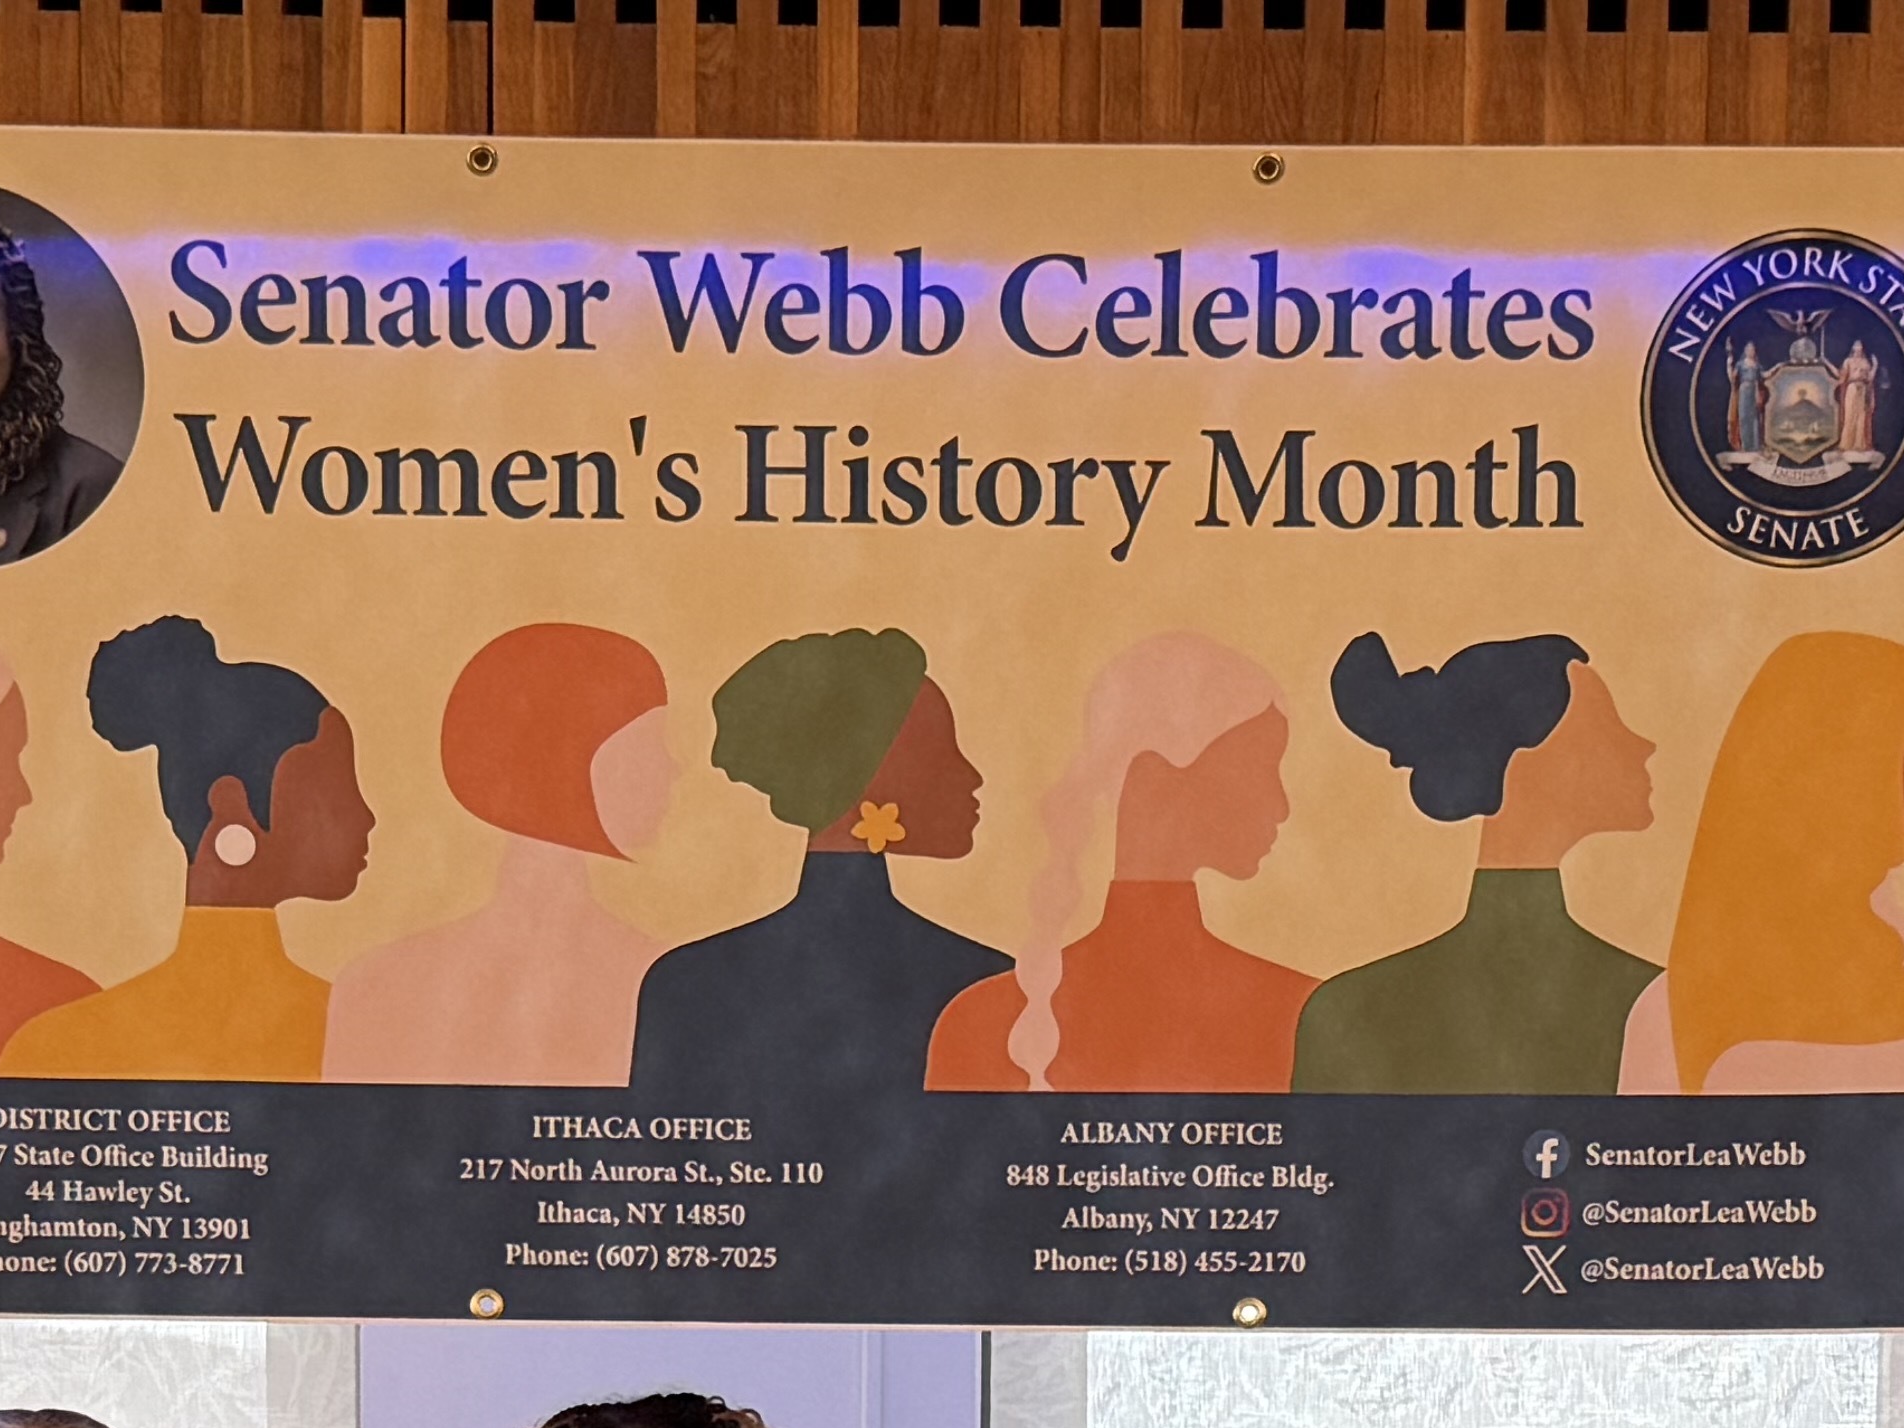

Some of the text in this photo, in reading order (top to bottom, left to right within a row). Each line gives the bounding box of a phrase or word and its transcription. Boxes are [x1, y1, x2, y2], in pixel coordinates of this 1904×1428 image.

[169, 240, 1595, 360] Senator Webb Celebrates
[1668, 273, 1736, 363] NEW
[1742, 247, 1851, 287] YORK
[173, 413, 1584, 562] Women's History Month
[1727, 507, 1869, 551] SENATE
[128, 1110, 231, 1133] OFFICE
[533, 1116, 752, 1141] ITHACA OFFICE
[1060, 1122, 1283, 1145] ALBANY OFFICE
[14, 1143, 75, 1166] State
[81, 1145, 154, 1167] Office
[162, 1145, 269, 1175] Building
[1585, 1141, 1807, 1167] SenatorLeaWebb
[459, 1158, 824, 1186] 217 North Aurora St., Ste. 110
[1006, 1164, 1335, 1195] 848 Legislative Office Bldg.
[25, 1180, 191, 1209] 44 Hawley St.
[537, 1201, 746, 1227] Ithaca, NY 14850
[1061, 1206, 1280, 1236] Albany, NY 12247
[1582, 1198, 1817, 1226] @SenatorLeaWebb
[132, 1216, 173, 1239] NY
[182, 1218, 251, 1240] 13901
[64, 1250, 126, 1277] (607)
[135, 1253, 244, 1275] 773-8771
[505, 1243, 778, 1271] Phone: (607) 878-7025
[1034, 1248, 1307, 1277] Phone: (518) 455-2170
[1580, 1255, 1825, 1283] @SenatorLeaWebb
